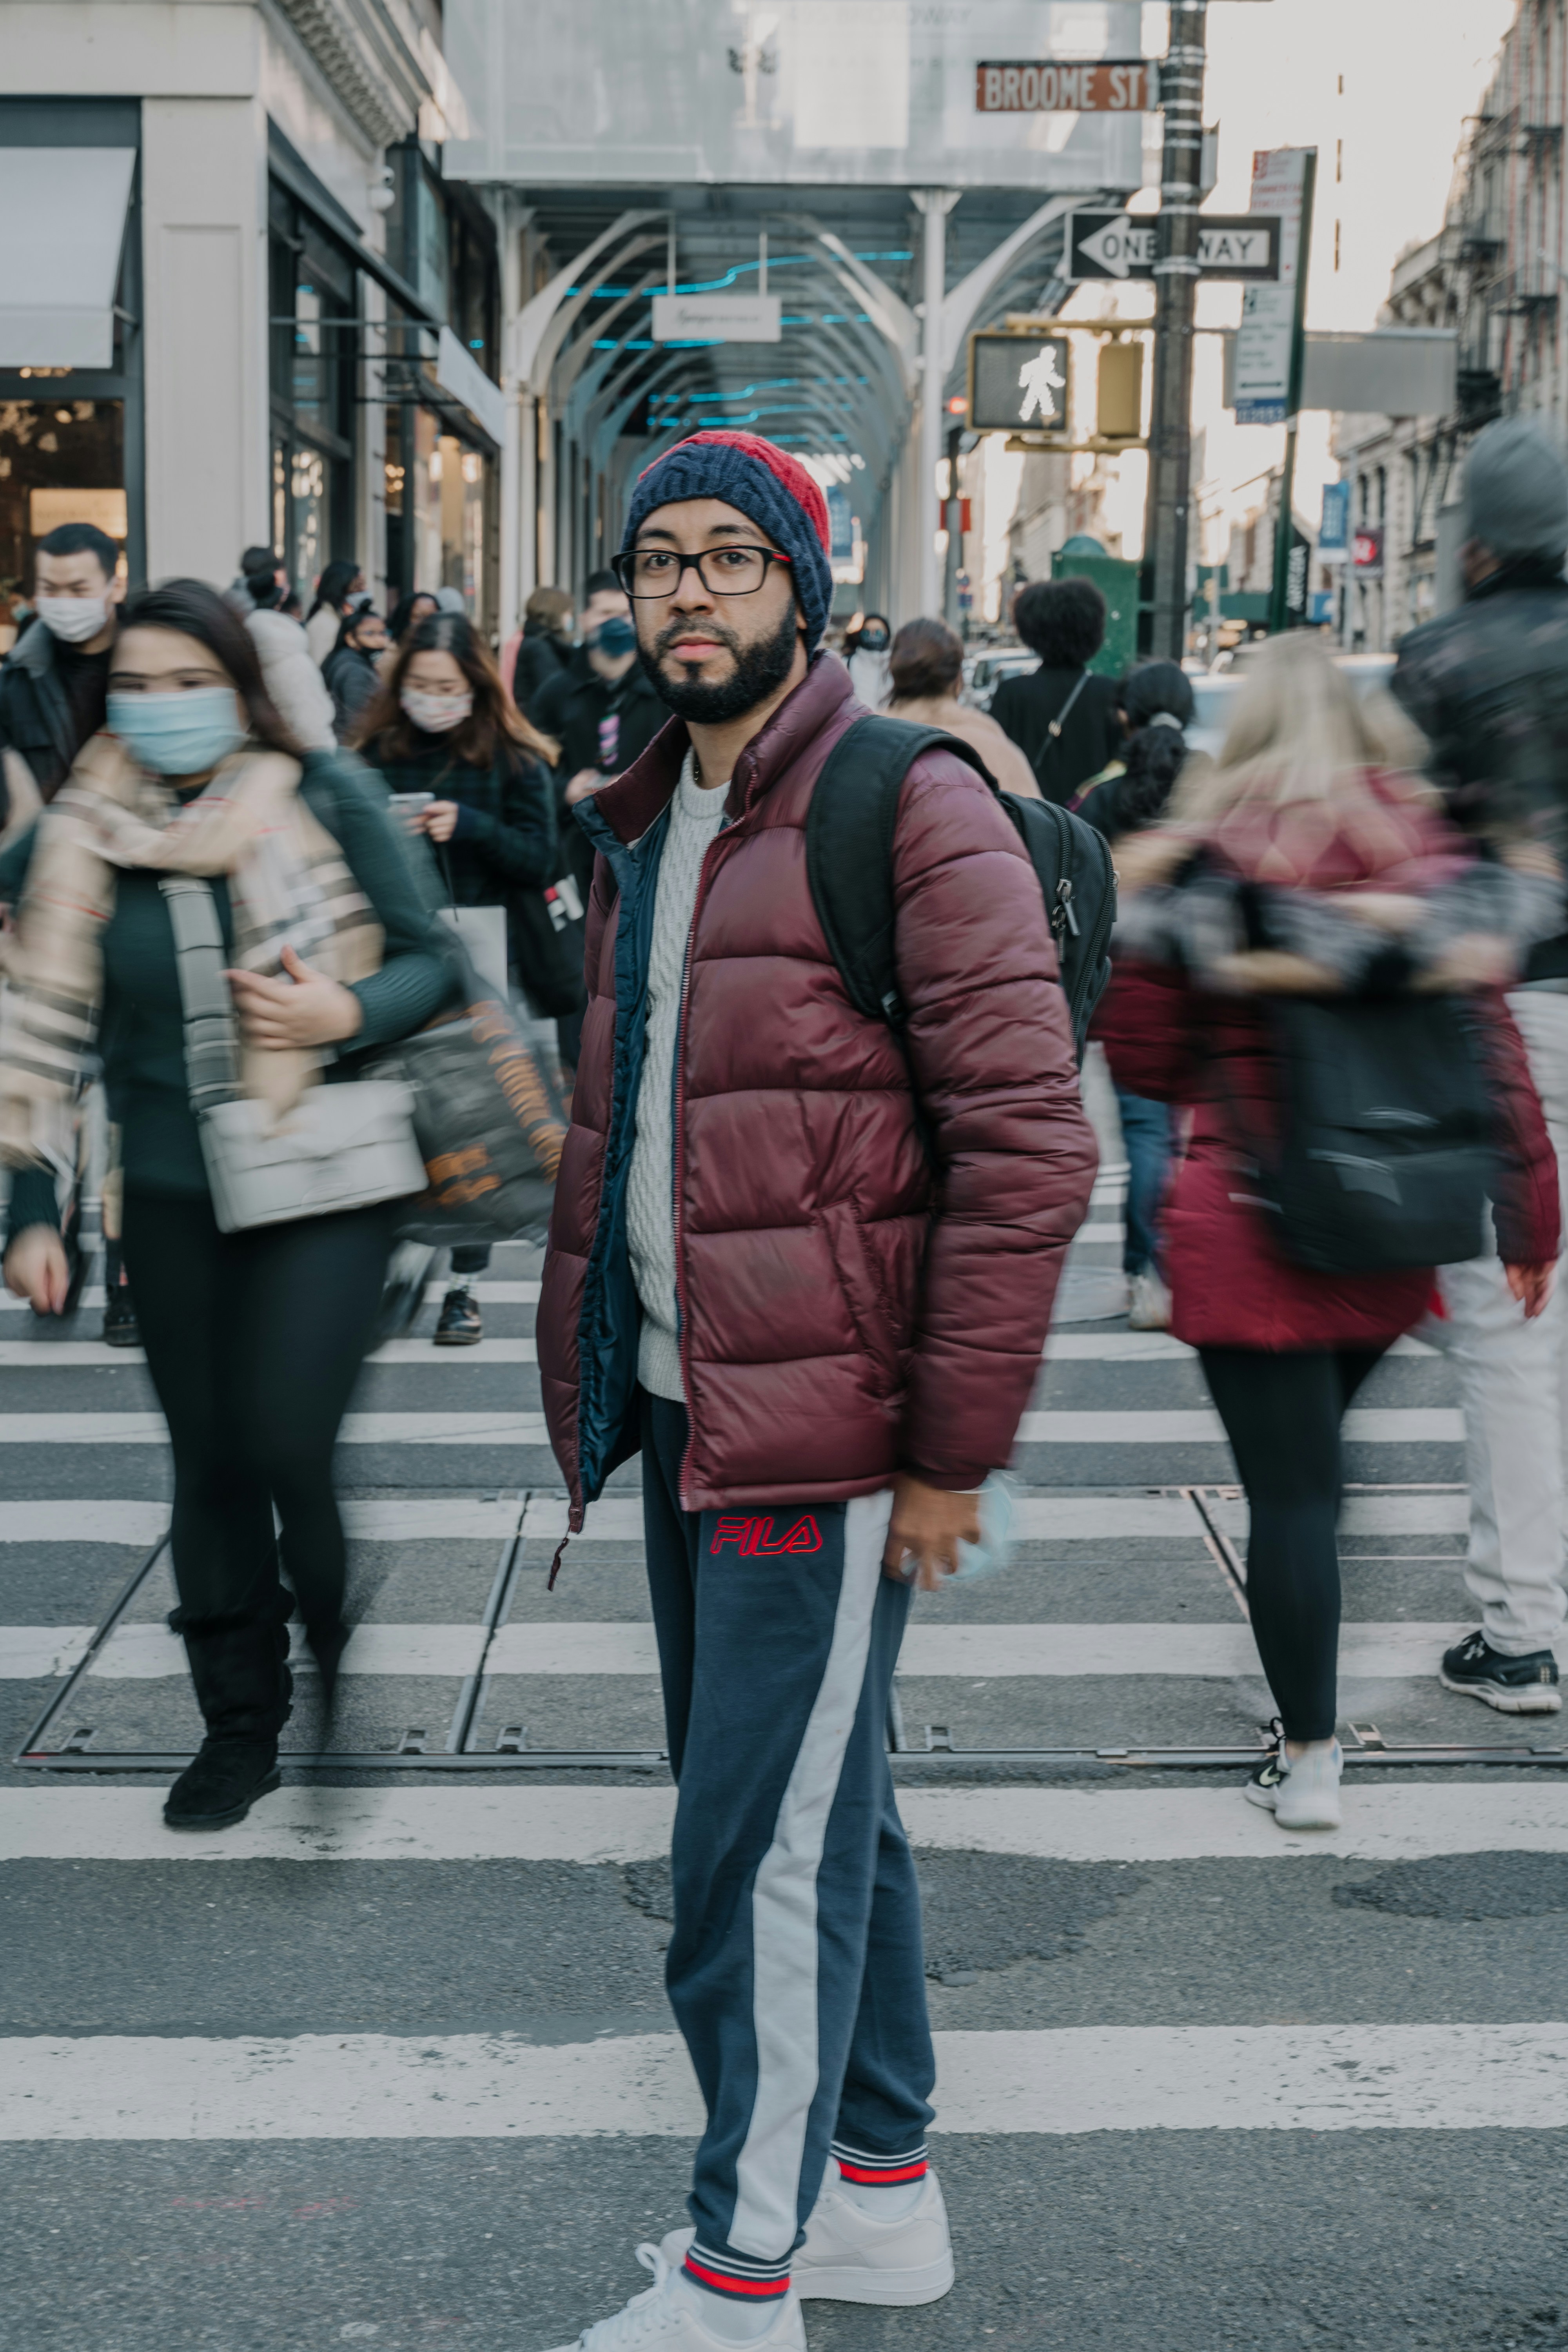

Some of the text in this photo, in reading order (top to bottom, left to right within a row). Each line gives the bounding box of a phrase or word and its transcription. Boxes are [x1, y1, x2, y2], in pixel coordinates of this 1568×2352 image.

[984, 66, 1143, 110] BROOME ST
[1102, 235, 1157, 260] ONE
[710, 1515, 822, 1556] FILA
